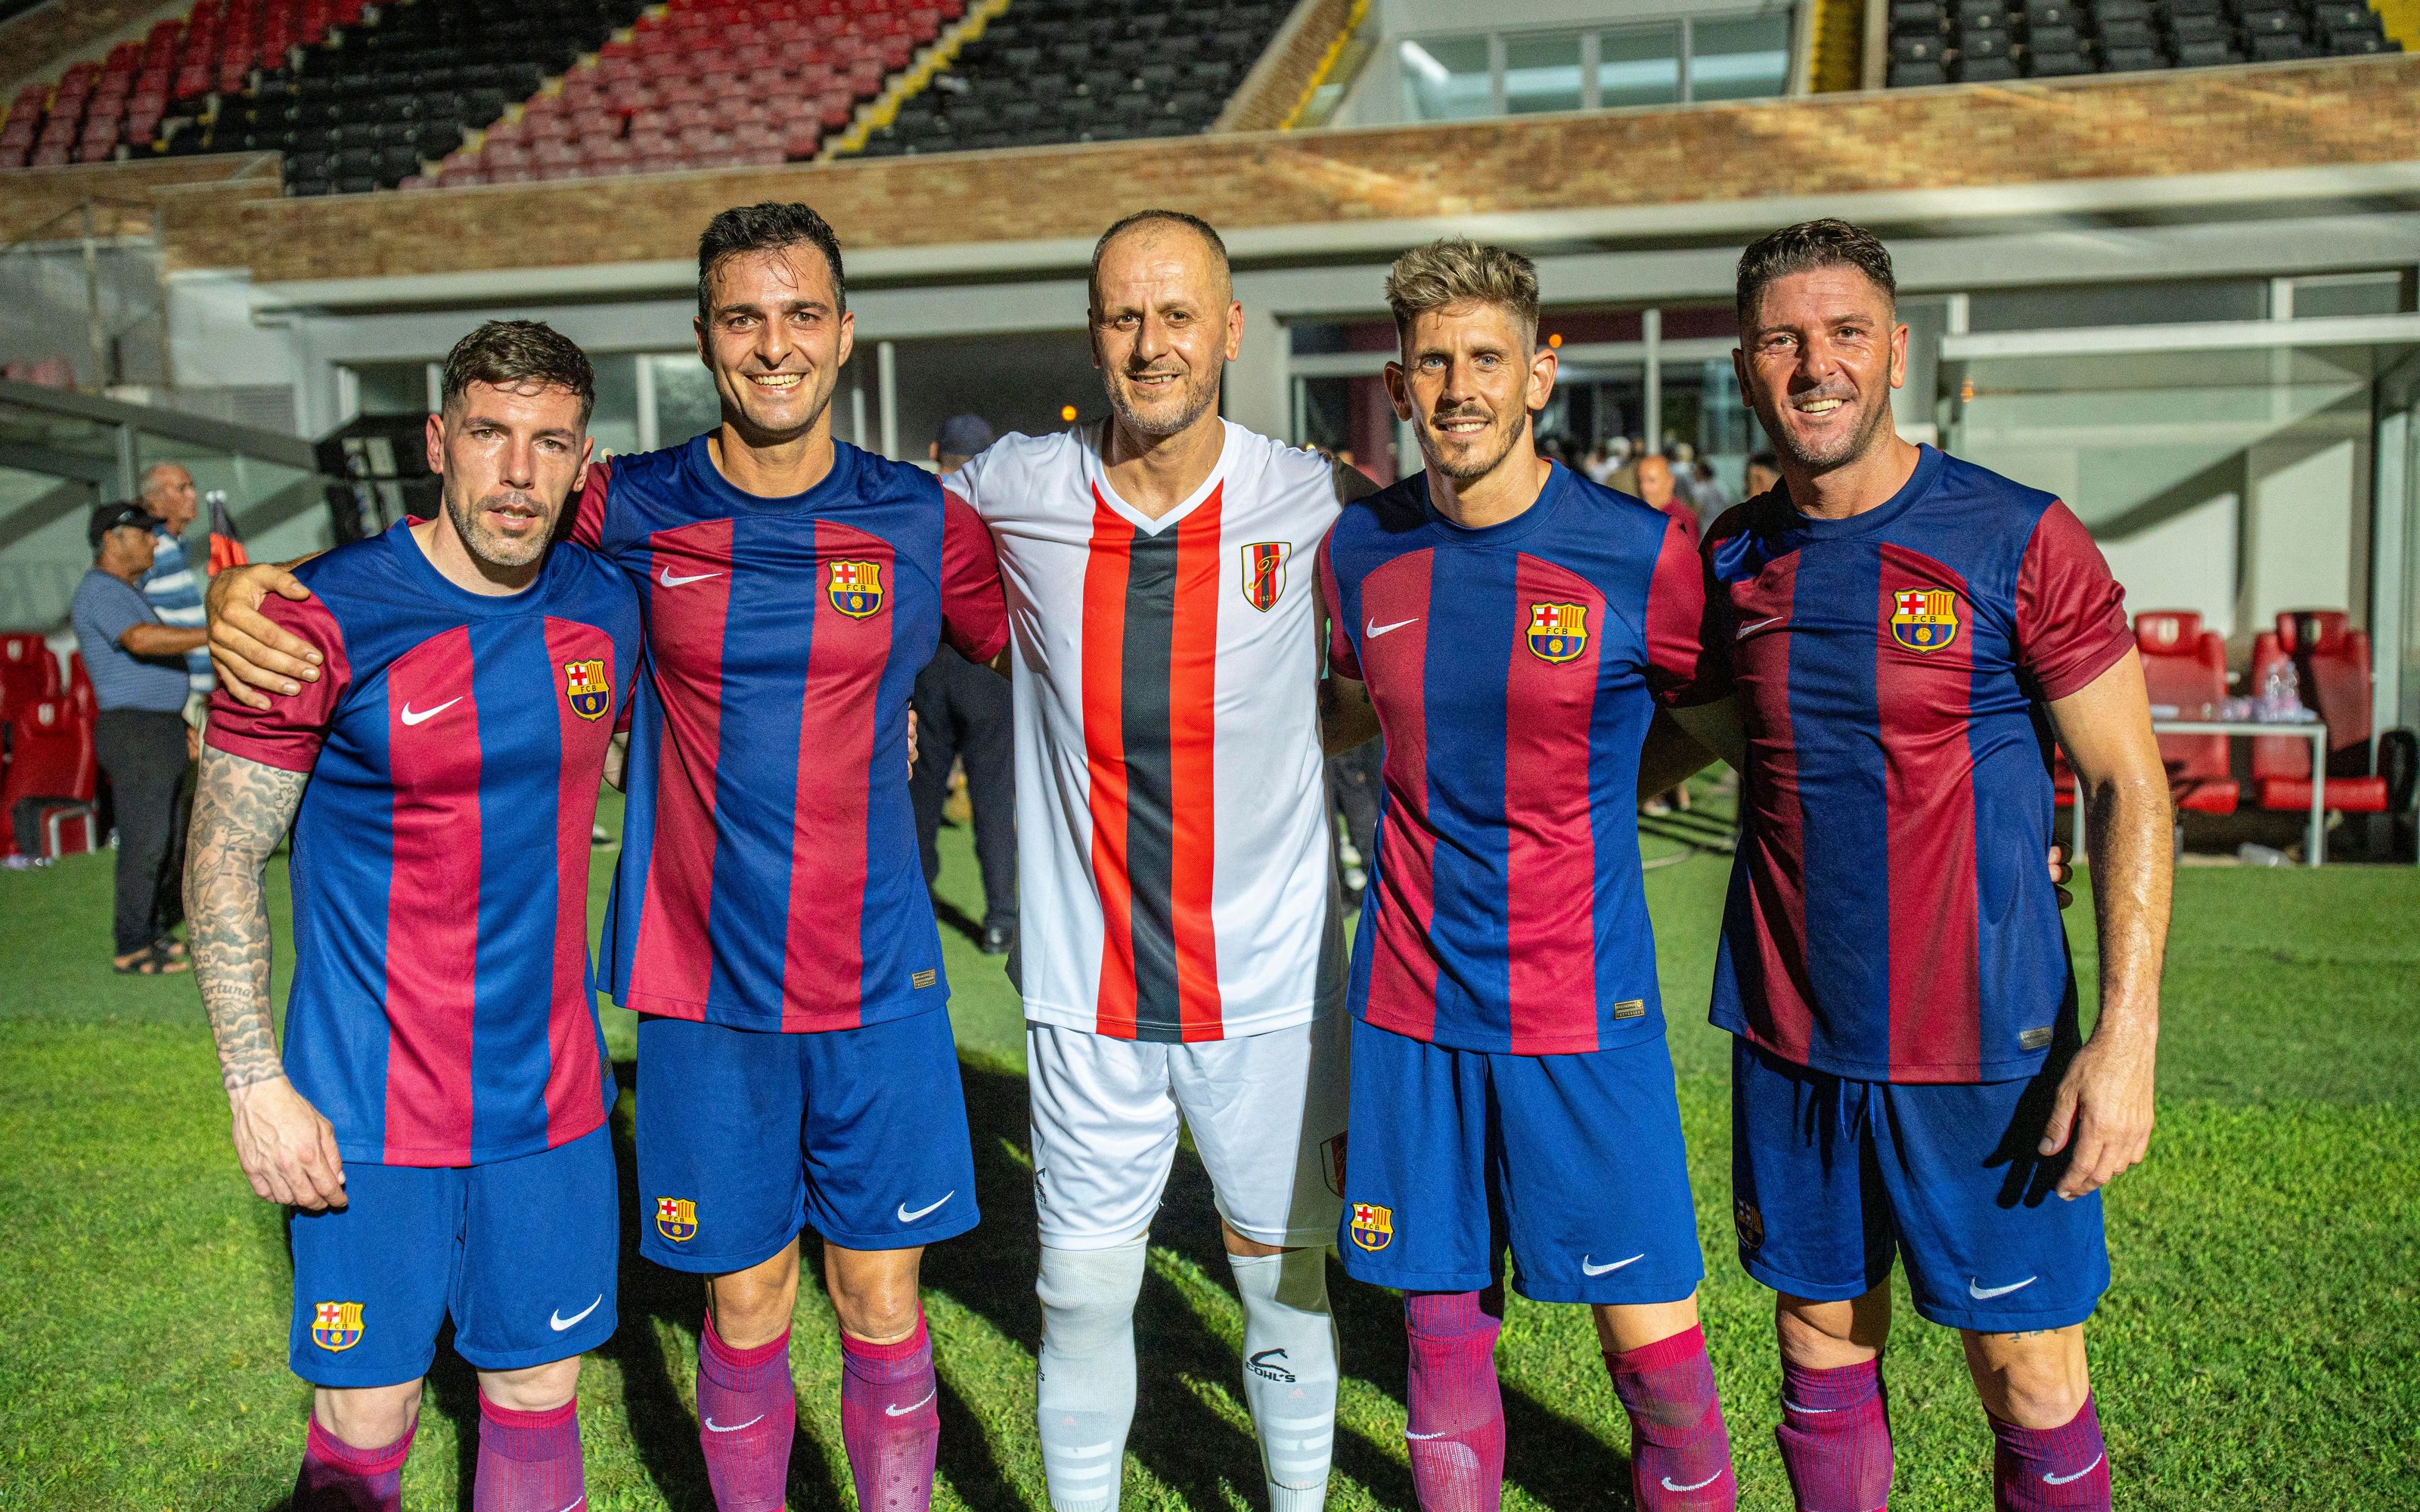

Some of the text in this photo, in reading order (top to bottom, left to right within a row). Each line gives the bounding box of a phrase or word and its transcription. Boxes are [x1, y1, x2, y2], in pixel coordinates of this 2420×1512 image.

[845, 584, 867, 592] FCB
[1546, 627, 1568, 635] FCB
[580, 685, 597, 693] FCB
[200, 980, 252, 997] ortuna
[1364, 1222, 1380, 1231] FCB
